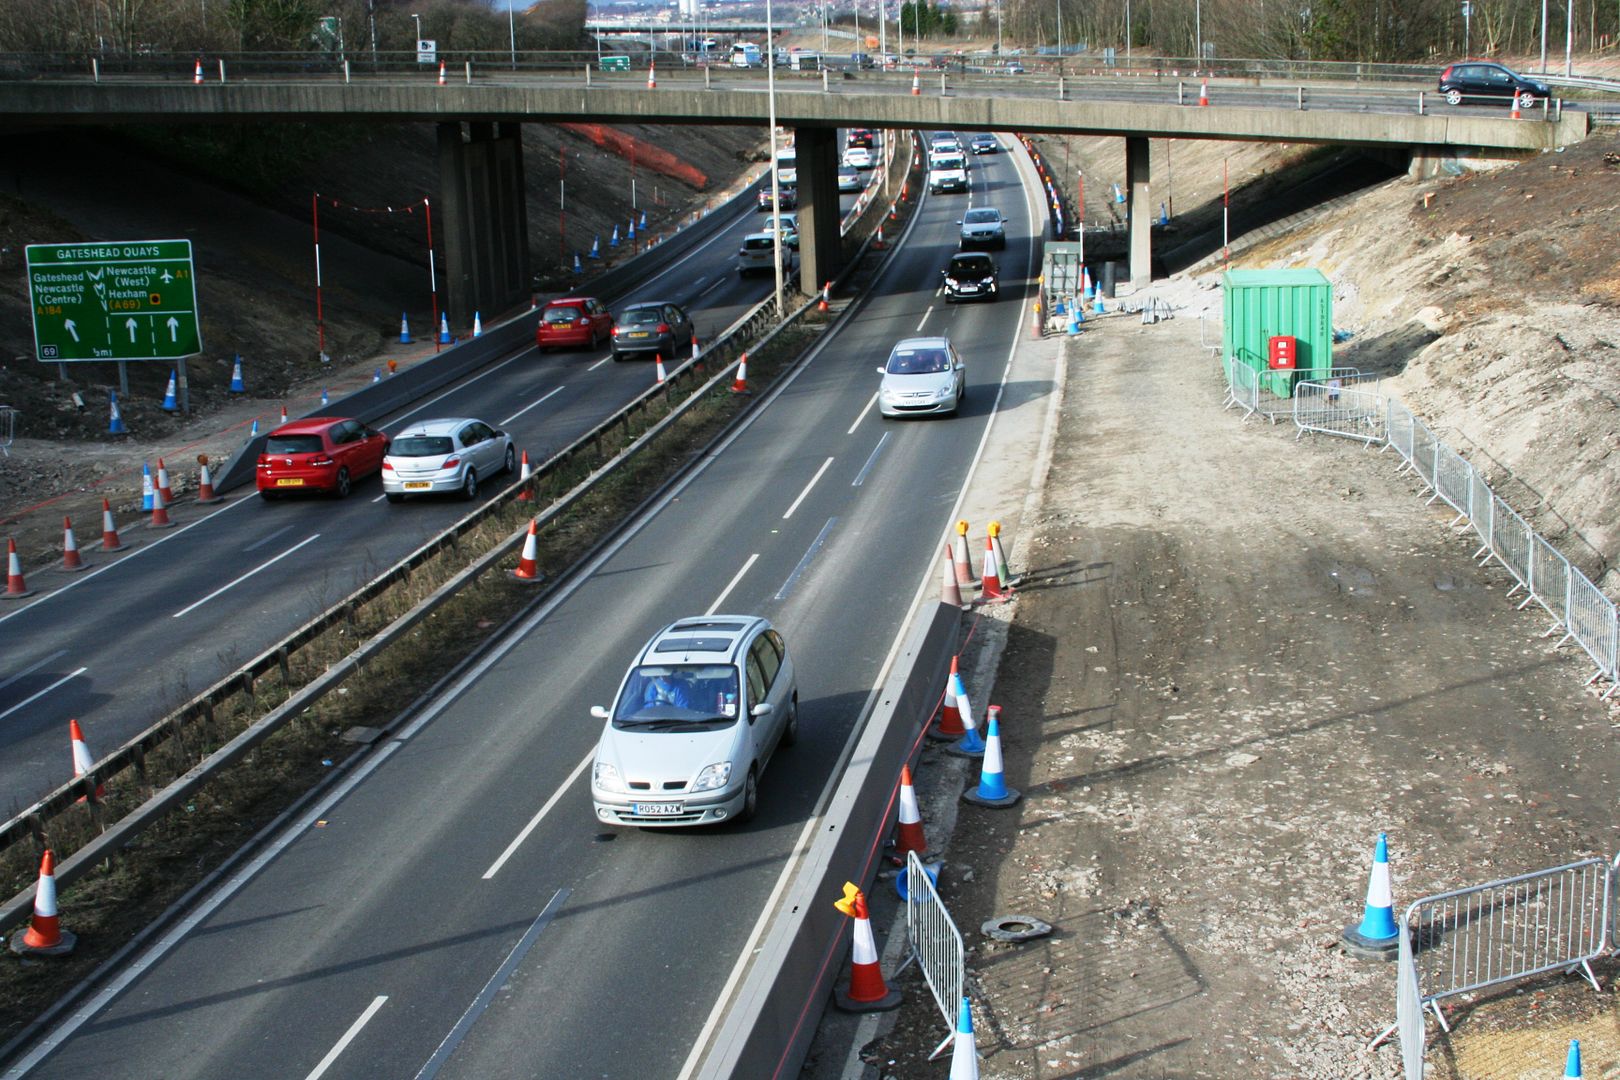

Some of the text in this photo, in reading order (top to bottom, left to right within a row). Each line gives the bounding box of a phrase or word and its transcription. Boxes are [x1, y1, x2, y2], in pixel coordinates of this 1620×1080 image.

[57, 246, 160, 259] GATESHEAD QUAYS
[106, 266, 157, 276] Newcastle
[175, 270, 188, 279] A1
[33, 272, 84, 283] Gateshead
[114, 276, 150, 288] (West)
[35, 285, 84, 294] Newcastle
[108, 289, 147, 299] Hexham
[39, 294, 82, 305] (Centre)
[108, 299, 141, 310] (A69)
[37, 306, 62, 315] A184
[43, 348, 56, 356] 69
[639, 805, 661, 813] RO52
